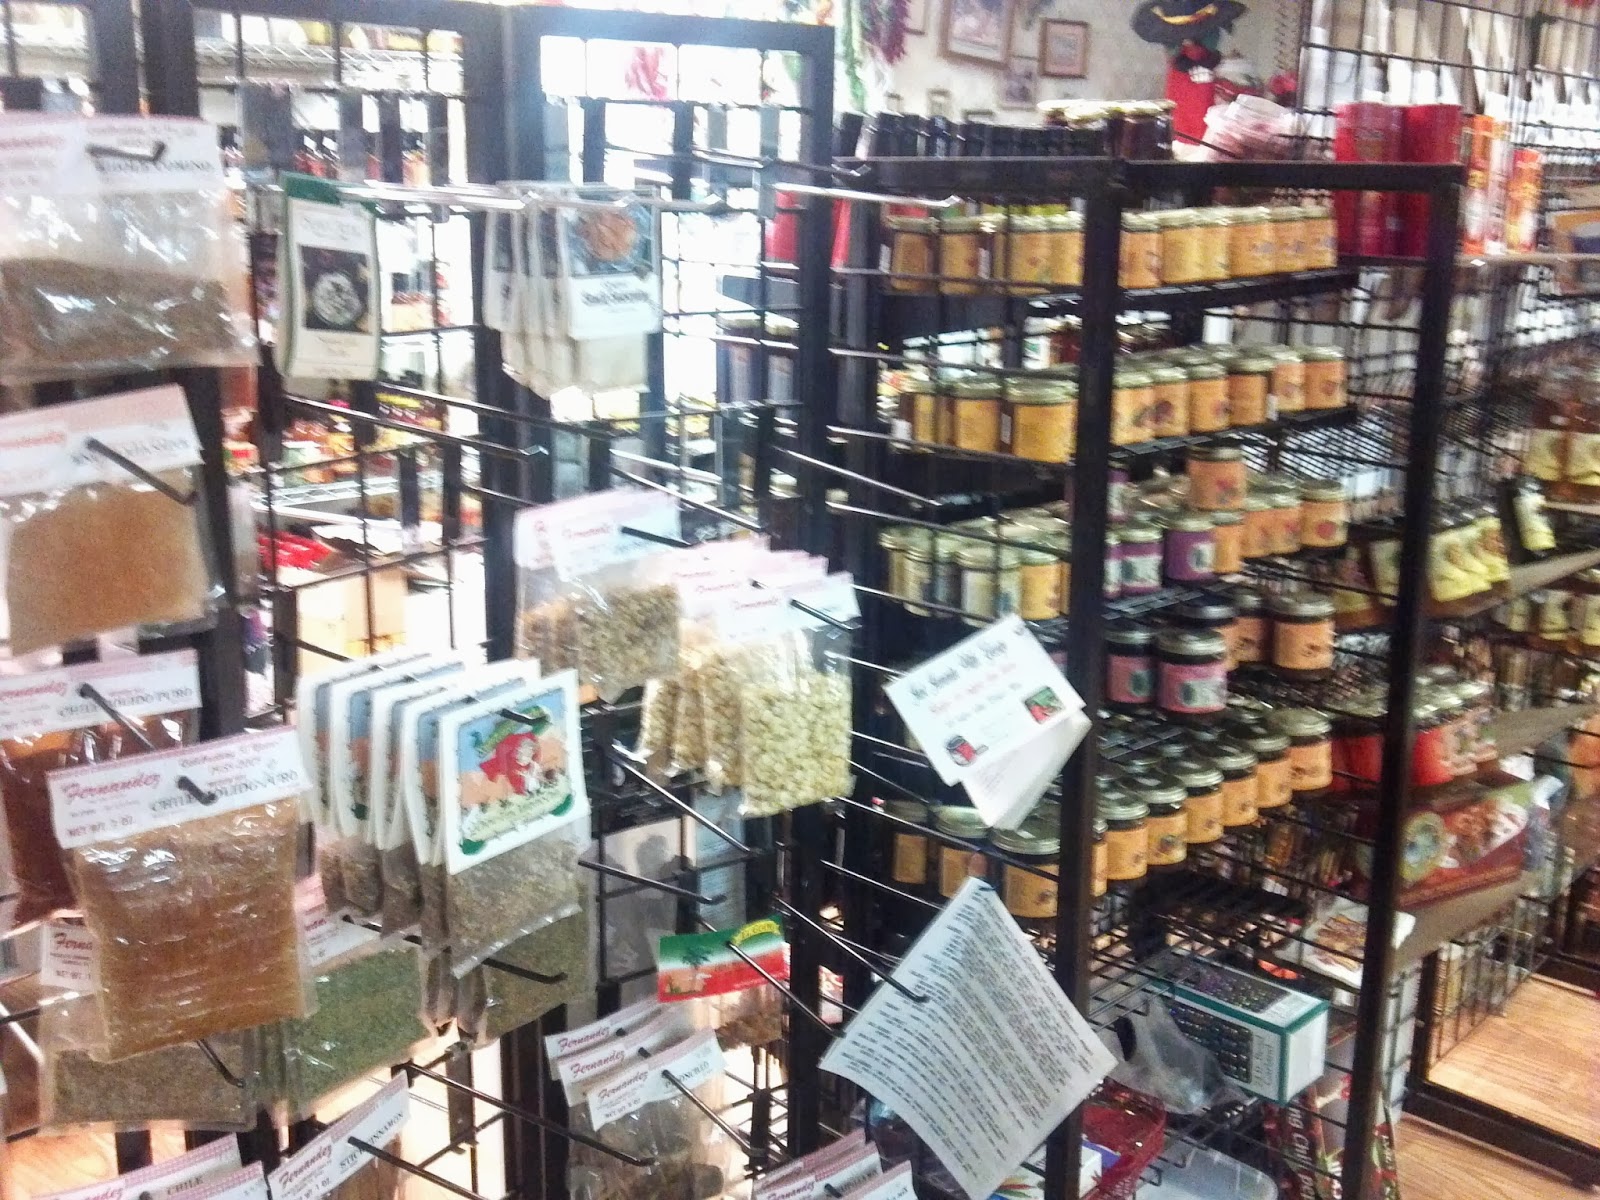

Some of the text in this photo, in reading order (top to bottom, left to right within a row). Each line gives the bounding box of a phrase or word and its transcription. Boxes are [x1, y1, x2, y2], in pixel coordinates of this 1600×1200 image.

[558, 1026, 610, 1050] Fernandez
[570, 1049, 626, 1078] Fernandez
[369, 1111, 405, 1144] INNAMON
[279, 1144, 334, 1190] Fernandez
